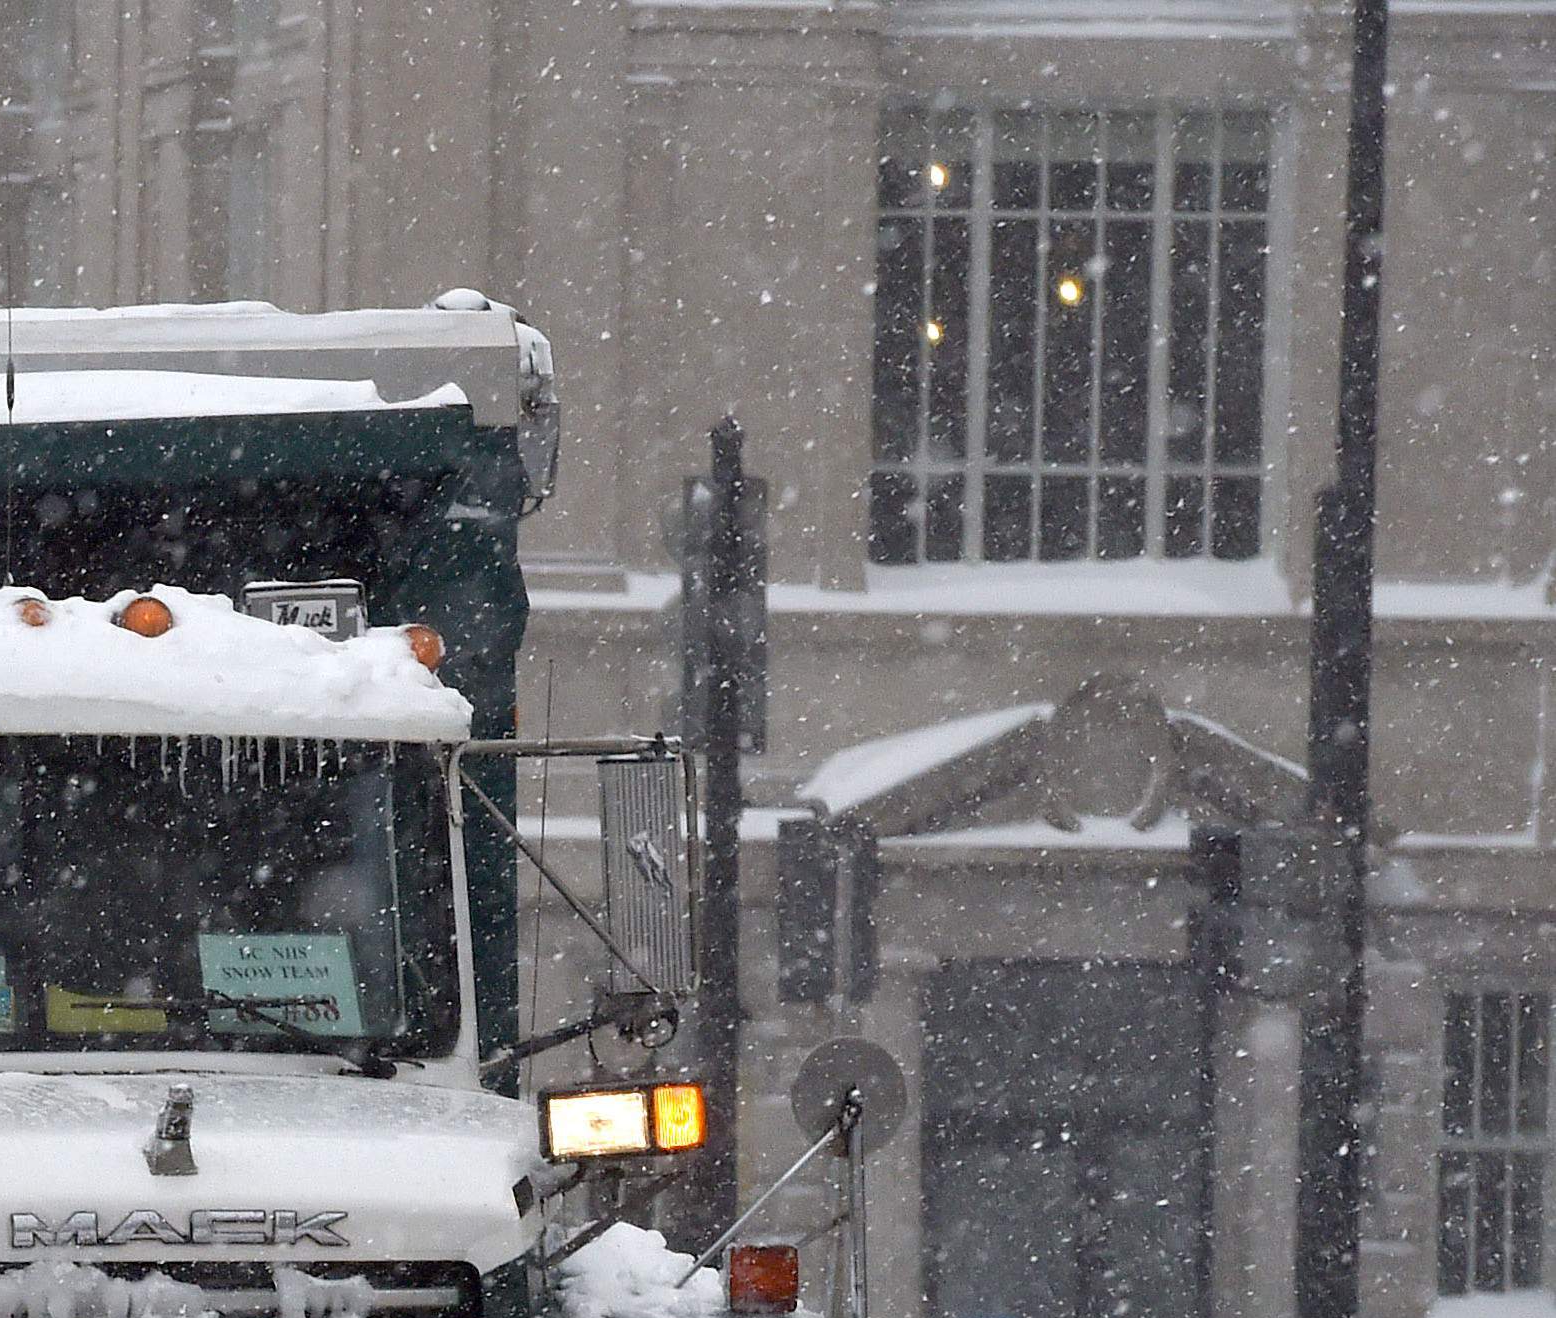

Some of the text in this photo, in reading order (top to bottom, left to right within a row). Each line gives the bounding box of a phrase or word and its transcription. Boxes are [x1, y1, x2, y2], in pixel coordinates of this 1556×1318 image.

[221, 965, 330, 980] SNOW TEAM
[10, 1209, 350, 1247] MACK
